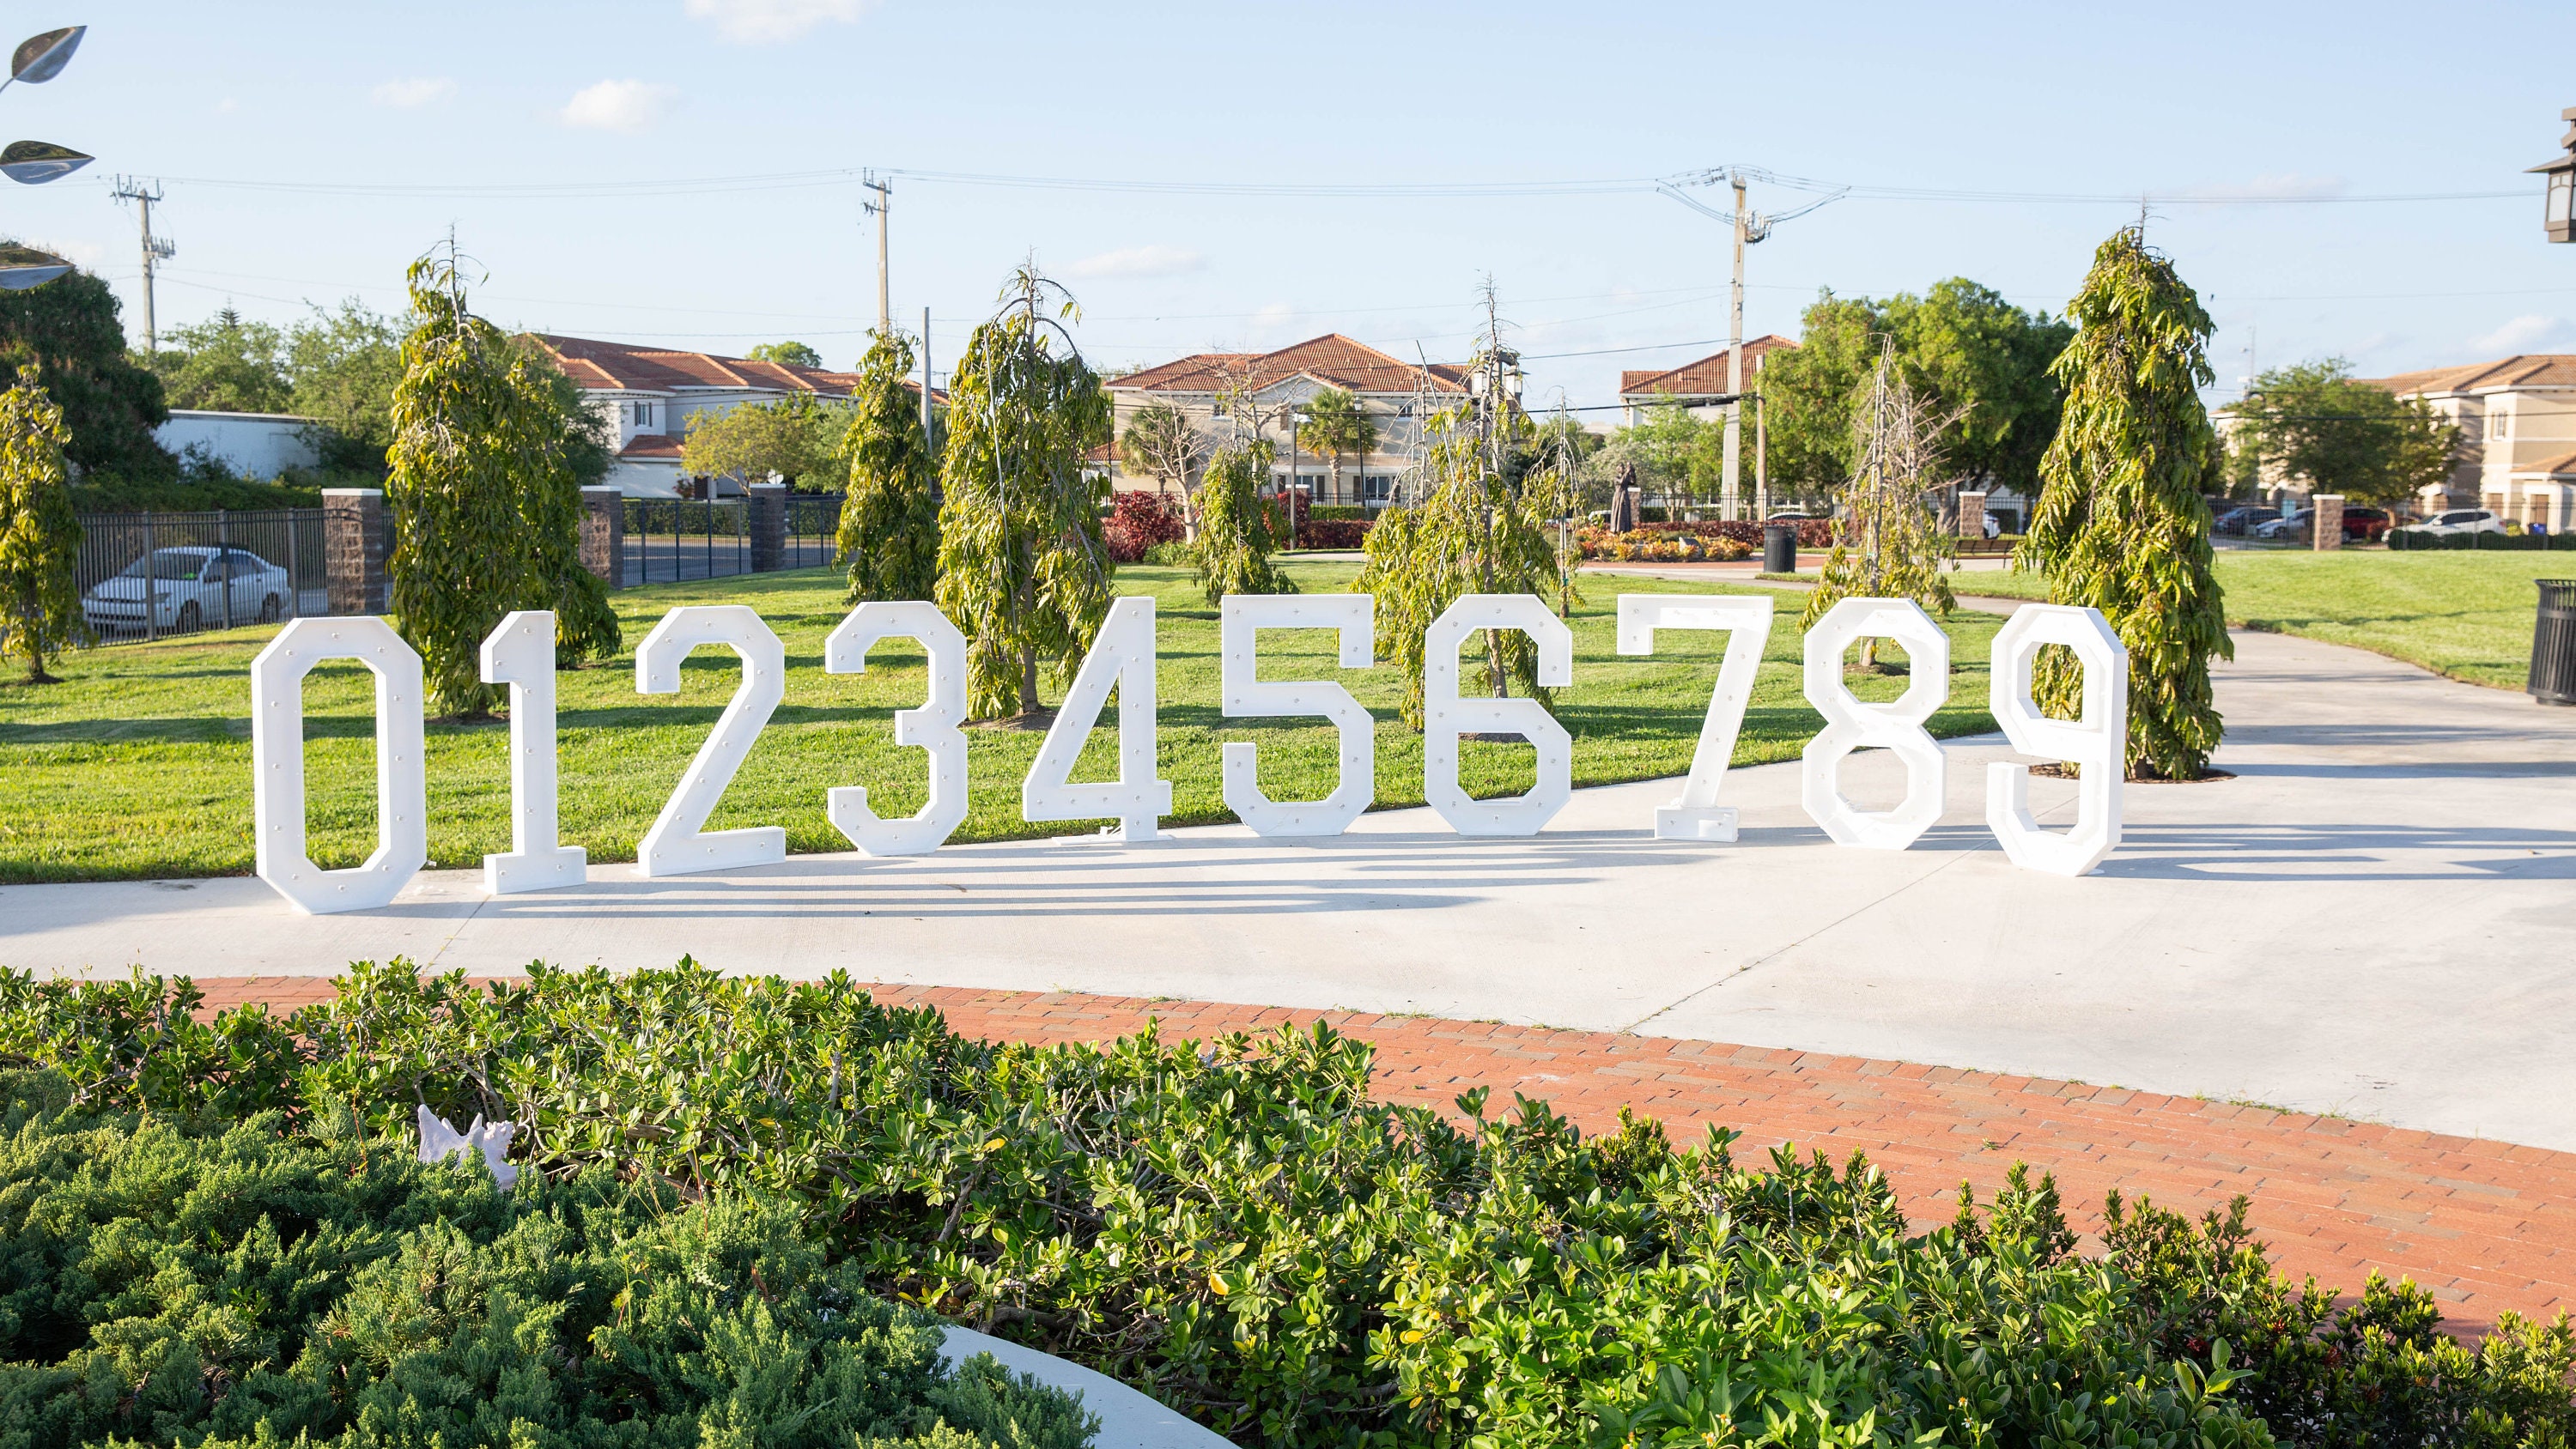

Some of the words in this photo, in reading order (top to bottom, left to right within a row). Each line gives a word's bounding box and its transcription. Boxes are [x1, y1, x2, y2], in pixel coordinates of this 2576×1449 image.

[251, 616, 427, 913] 0
[480, 610, 587, 894] 1
[635, 605, 786, 876] 2
[825, 601, 968, 857] 3
[1023, 597, 1172, 842] 4
[1221, 594, 1374, 836] 5
[1425, 594, 1572, 836] 6
[1617, 594, 1773, 842] 7
[1801, 597, 1950, 850] 8
[1986, 603, 2128, 876] 9
